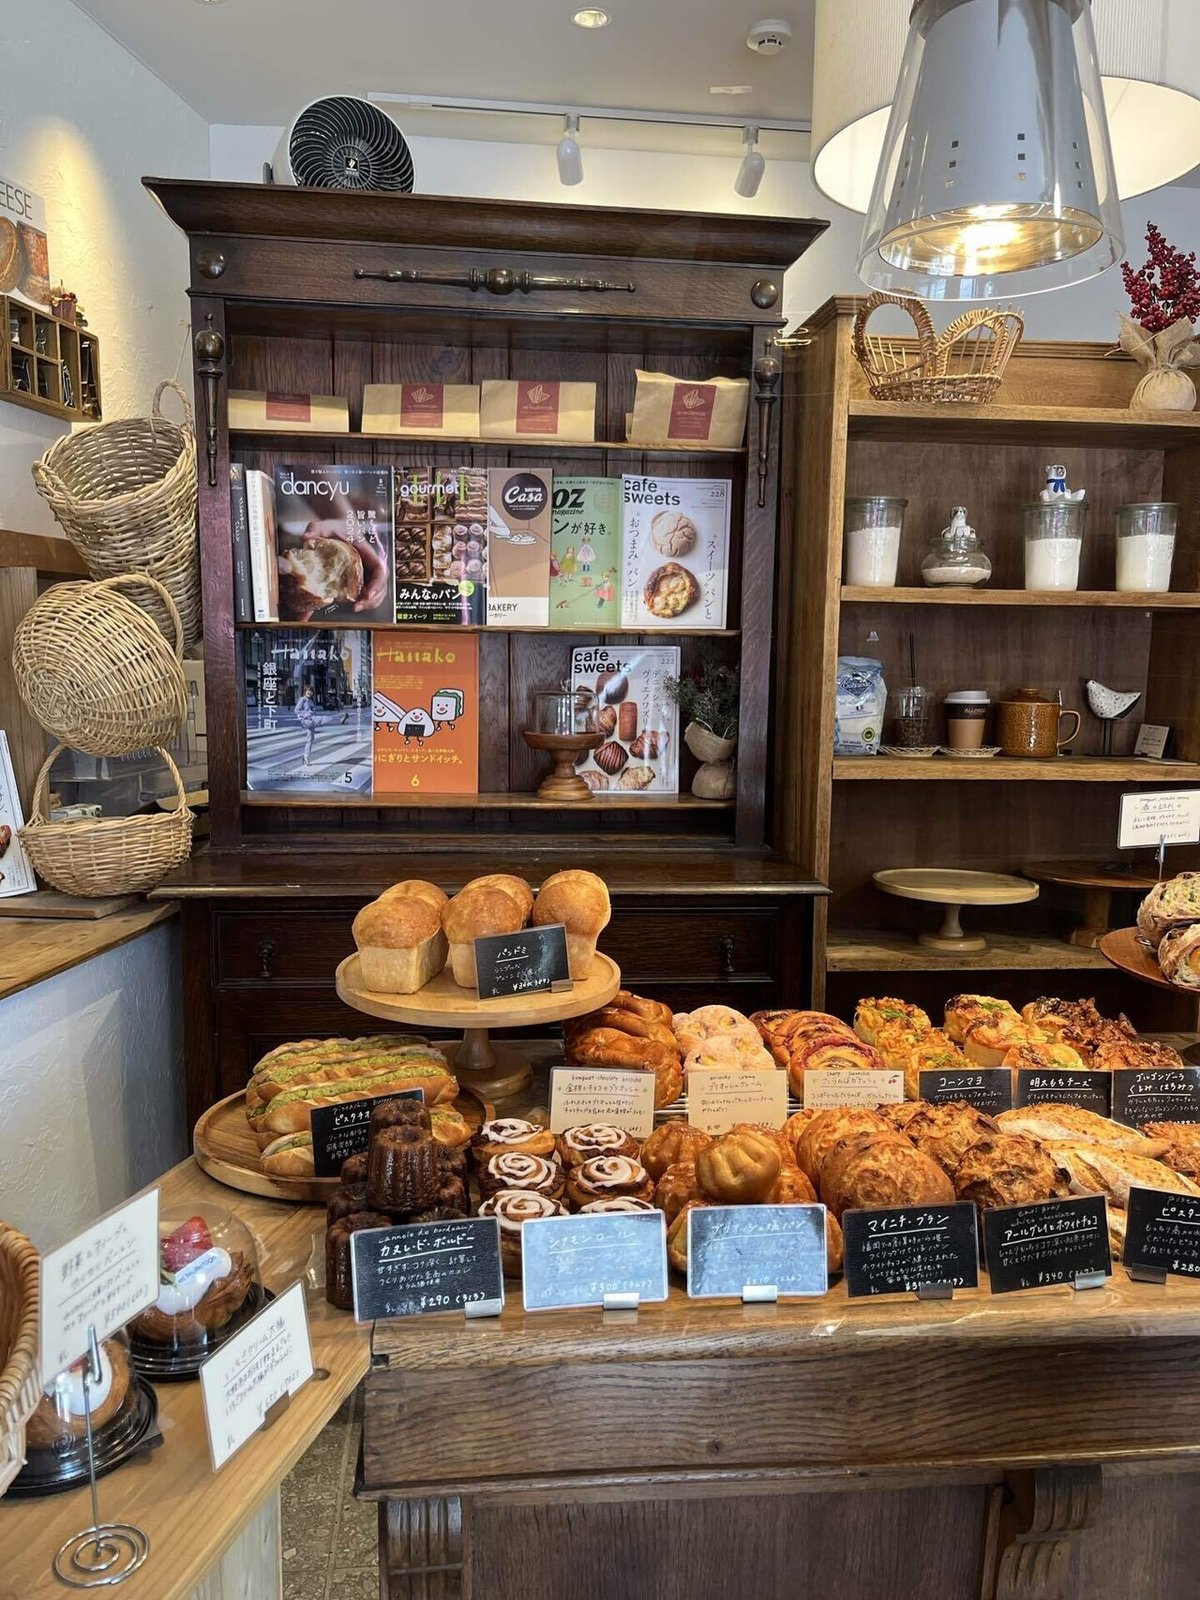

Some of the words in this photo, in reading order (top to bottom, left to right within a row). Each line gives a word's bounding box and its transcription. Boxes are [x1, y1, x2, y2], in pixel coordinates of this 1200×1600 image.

[281, 472, 349, 501] dancyu
[400, 483, 460, 498] gourmet
[504, 486, 544, 503] Casa
[624, 491, 681, 506] sweets
[346, 511, 355, 543] 2024
[357, 510, 366, 543] 旨いパン
[399, 588, 462, 600] みんなのパン
[574, 660, 632, 674] sweets
[263, 661, 278, 731] 銀座と下町
[642, 669, 650, 727] ヴィエノワズリ
[374, 753, 463, 764] にぎりとサンドイッチ。
[344, 772, 353, 783] 5
[411, 774, 420, 787] 6
[939, 1076, 983, 1087] コーンマヨ
[1029, 1077, 1092, 1088] 明太もちチーズ
[1135, 1071, 1185, 1083] ゴルゴンゾーラ
[867, 1213, 950, 1232] マイニチ・ブラン
[1038, 1271, 1064, 1283] ¥340
[420, 1295, 450, 1309] ¥290
